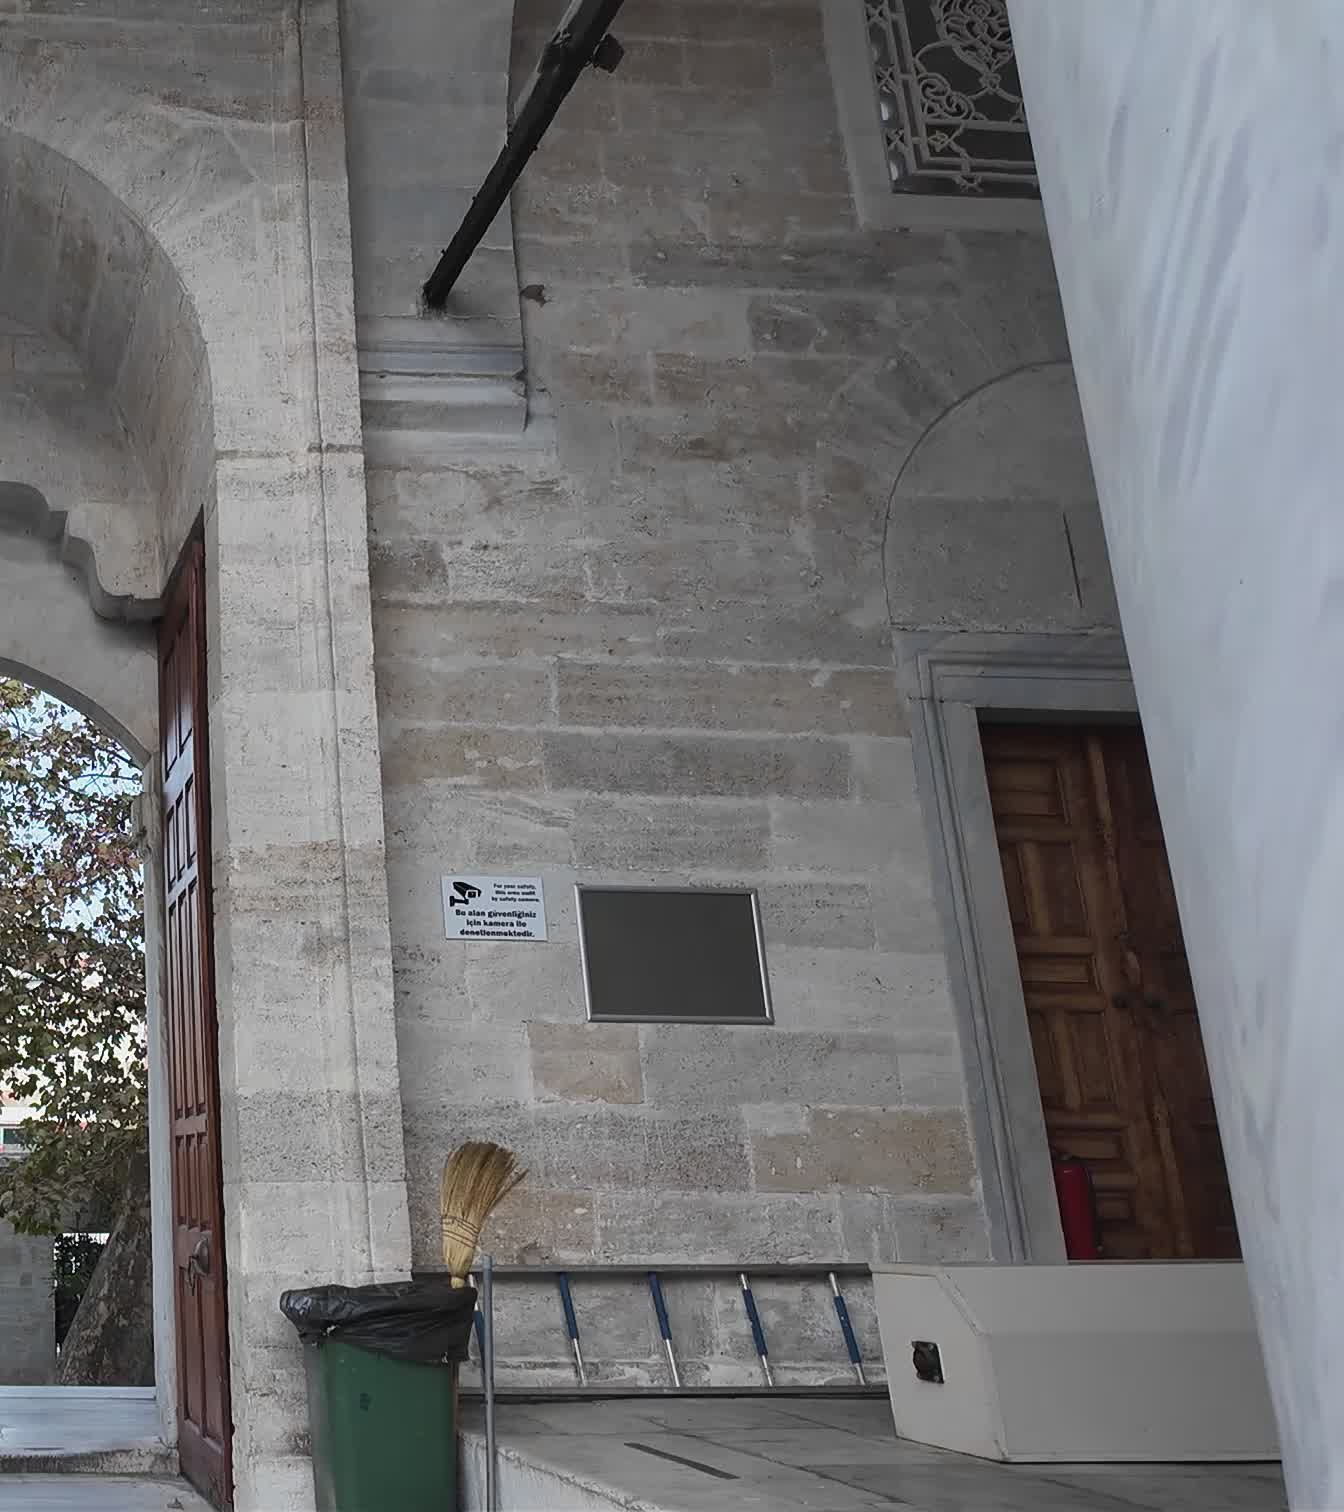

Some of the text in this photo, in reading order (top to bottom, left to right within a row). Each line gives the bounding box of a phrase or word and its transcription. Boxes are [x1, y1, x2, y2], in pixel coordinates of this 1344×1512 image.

[468, 909, 486, 917] alan
[487, 910, 537, 919] güvenliğiniz
[466, 919, 481, 927] için
[483, 919, 515, 927] kamera
[459, 928, 535, 937] denetlenmektedir.
